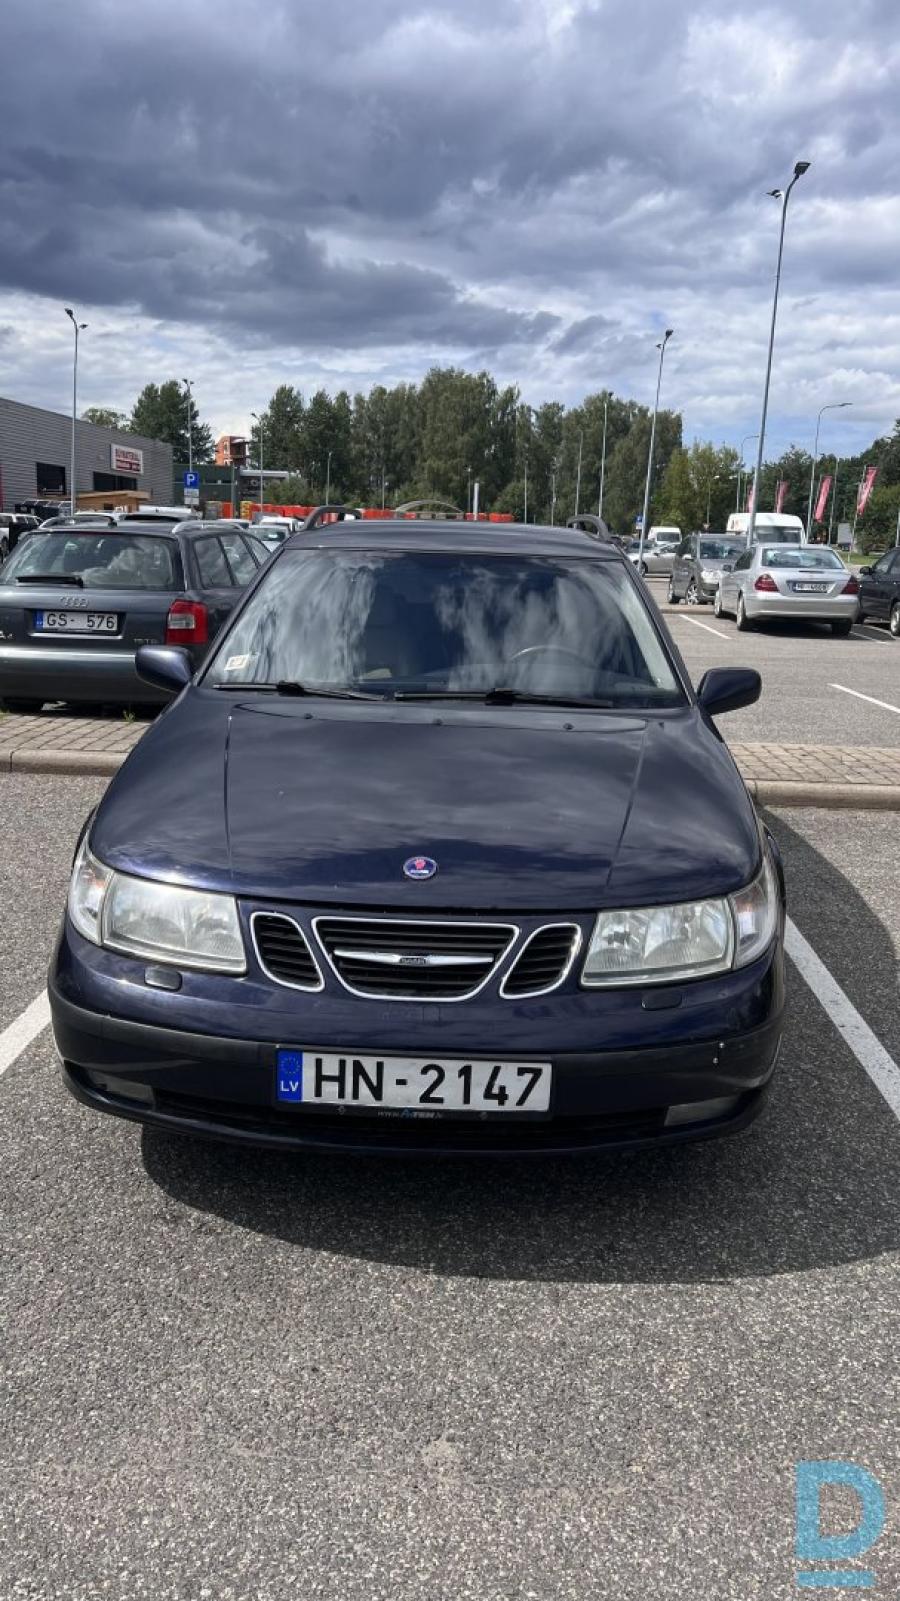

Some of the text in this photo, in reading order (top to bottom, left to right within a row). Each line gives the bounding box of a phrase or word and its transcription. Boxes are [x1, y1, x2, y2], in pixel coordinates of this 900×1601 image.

[187, 473, 195, 486] P
[279, 1080, 298, 1092] LV
[314, 1057, 544, 1107] HN-2147
